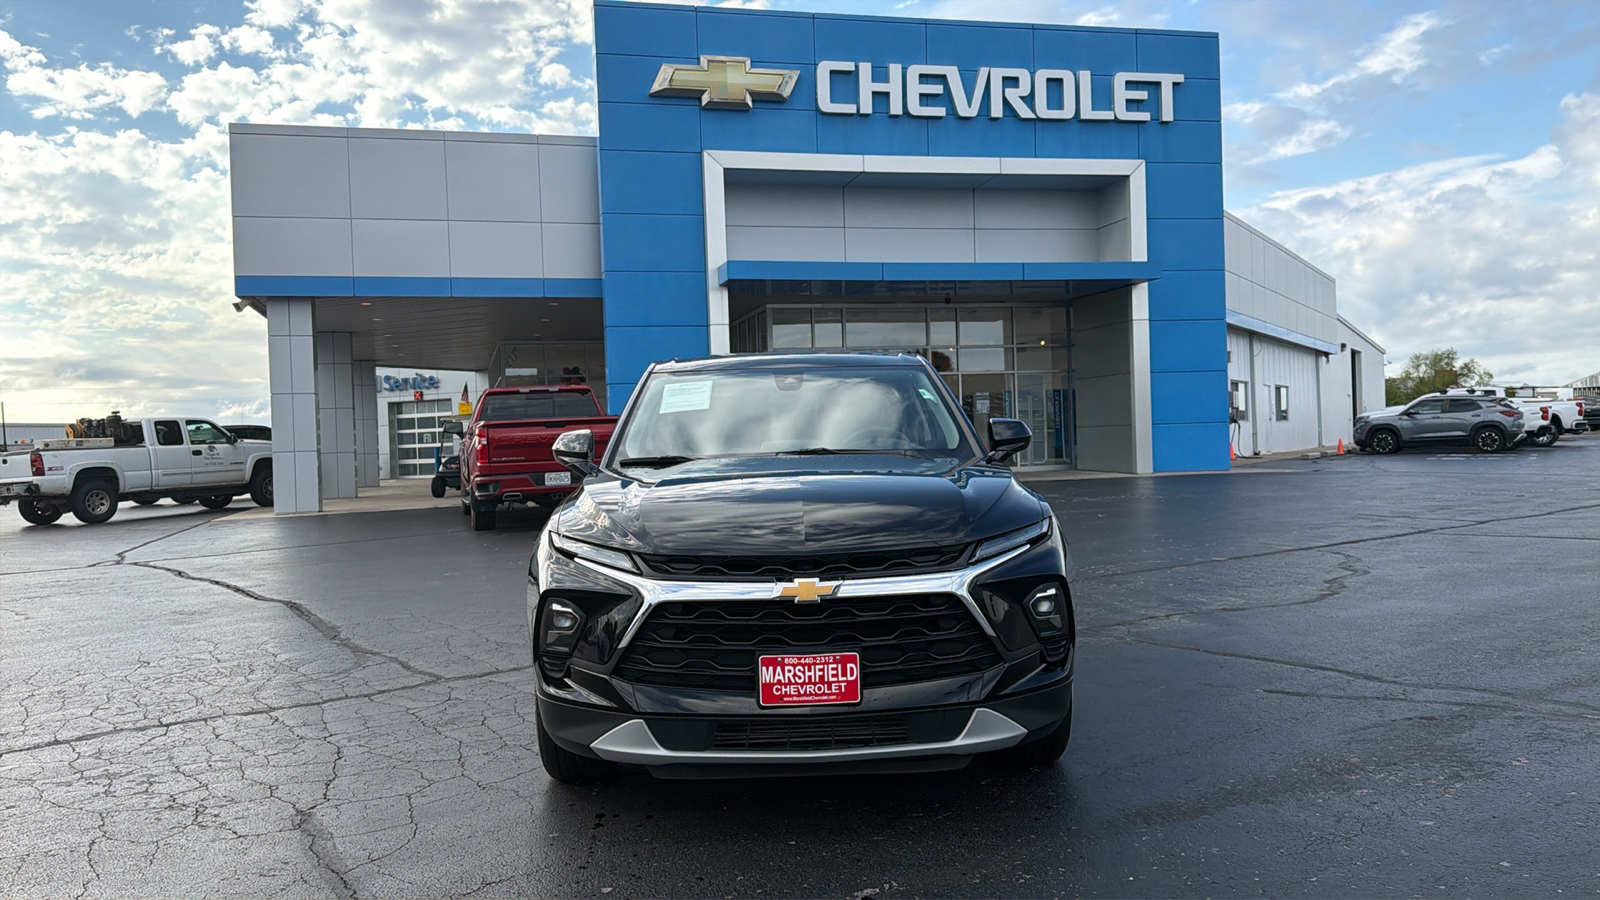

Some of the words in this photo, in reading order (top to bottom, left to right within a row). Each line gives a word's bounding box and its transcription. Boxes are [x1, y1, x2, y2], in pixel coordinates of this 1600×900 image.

[816, 60, 1185, 123] CHEVROLET
[383, 372, 438, 391] Service
[784, 656, 834, 664] 800-440-2312
[762, 663, 857, 684] MARSHFIELD
[772, 682, 847, 695] CHEVROLET
